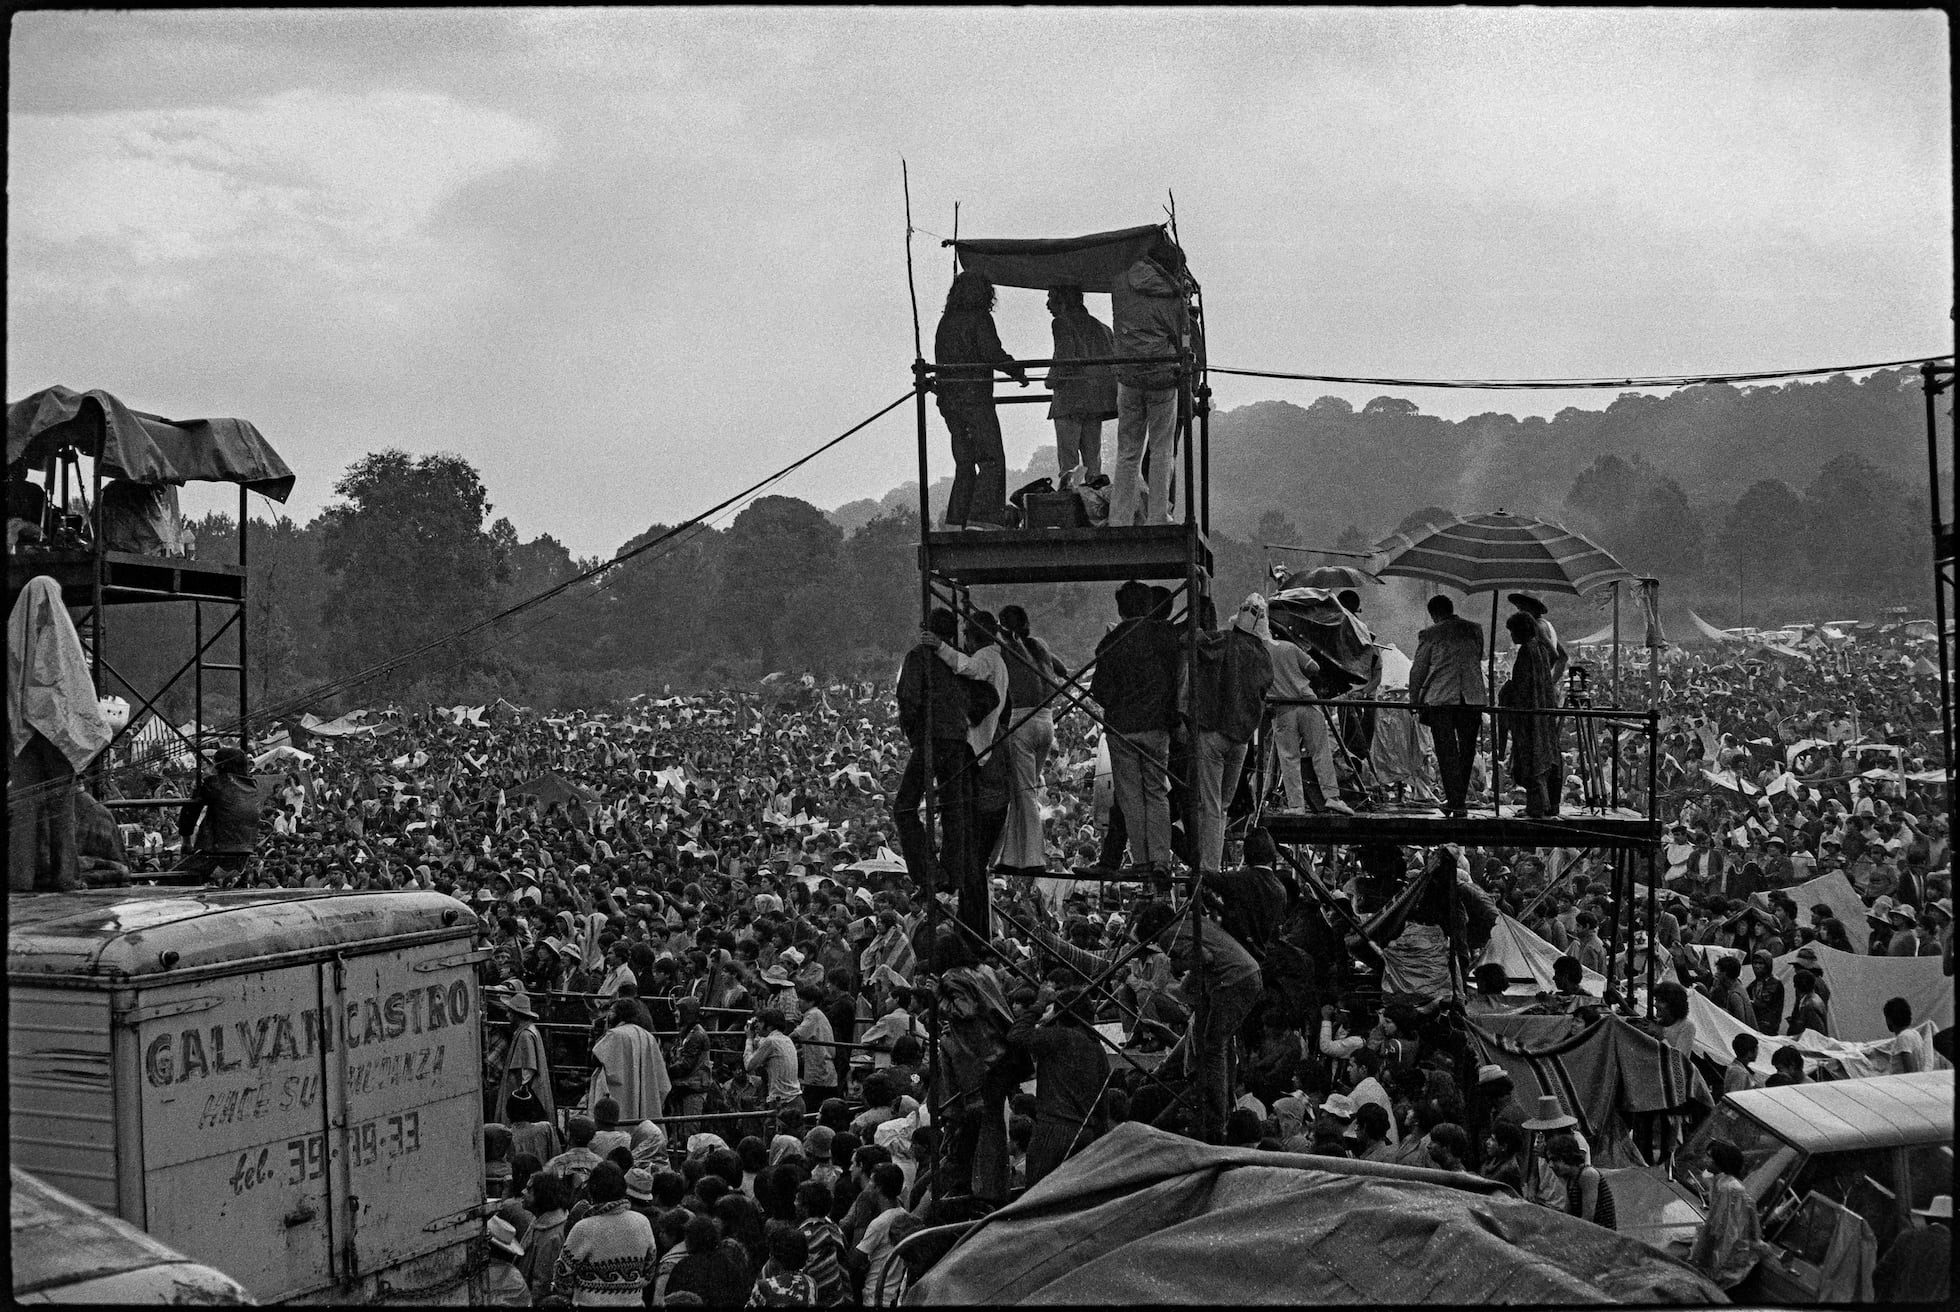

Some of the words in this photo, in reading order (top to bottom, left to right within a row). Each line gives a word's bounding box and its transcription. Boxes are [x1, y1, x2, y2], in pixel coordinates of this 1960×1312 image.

[146, 1005, 335, 1088] GALVAN
[346, 979, 469, 1049] CASTRO
[198, 1081, 273, 1130] HACE
[279, 1074, 319, 1112] SU
[229, 1148, 274, 1196] tel.
